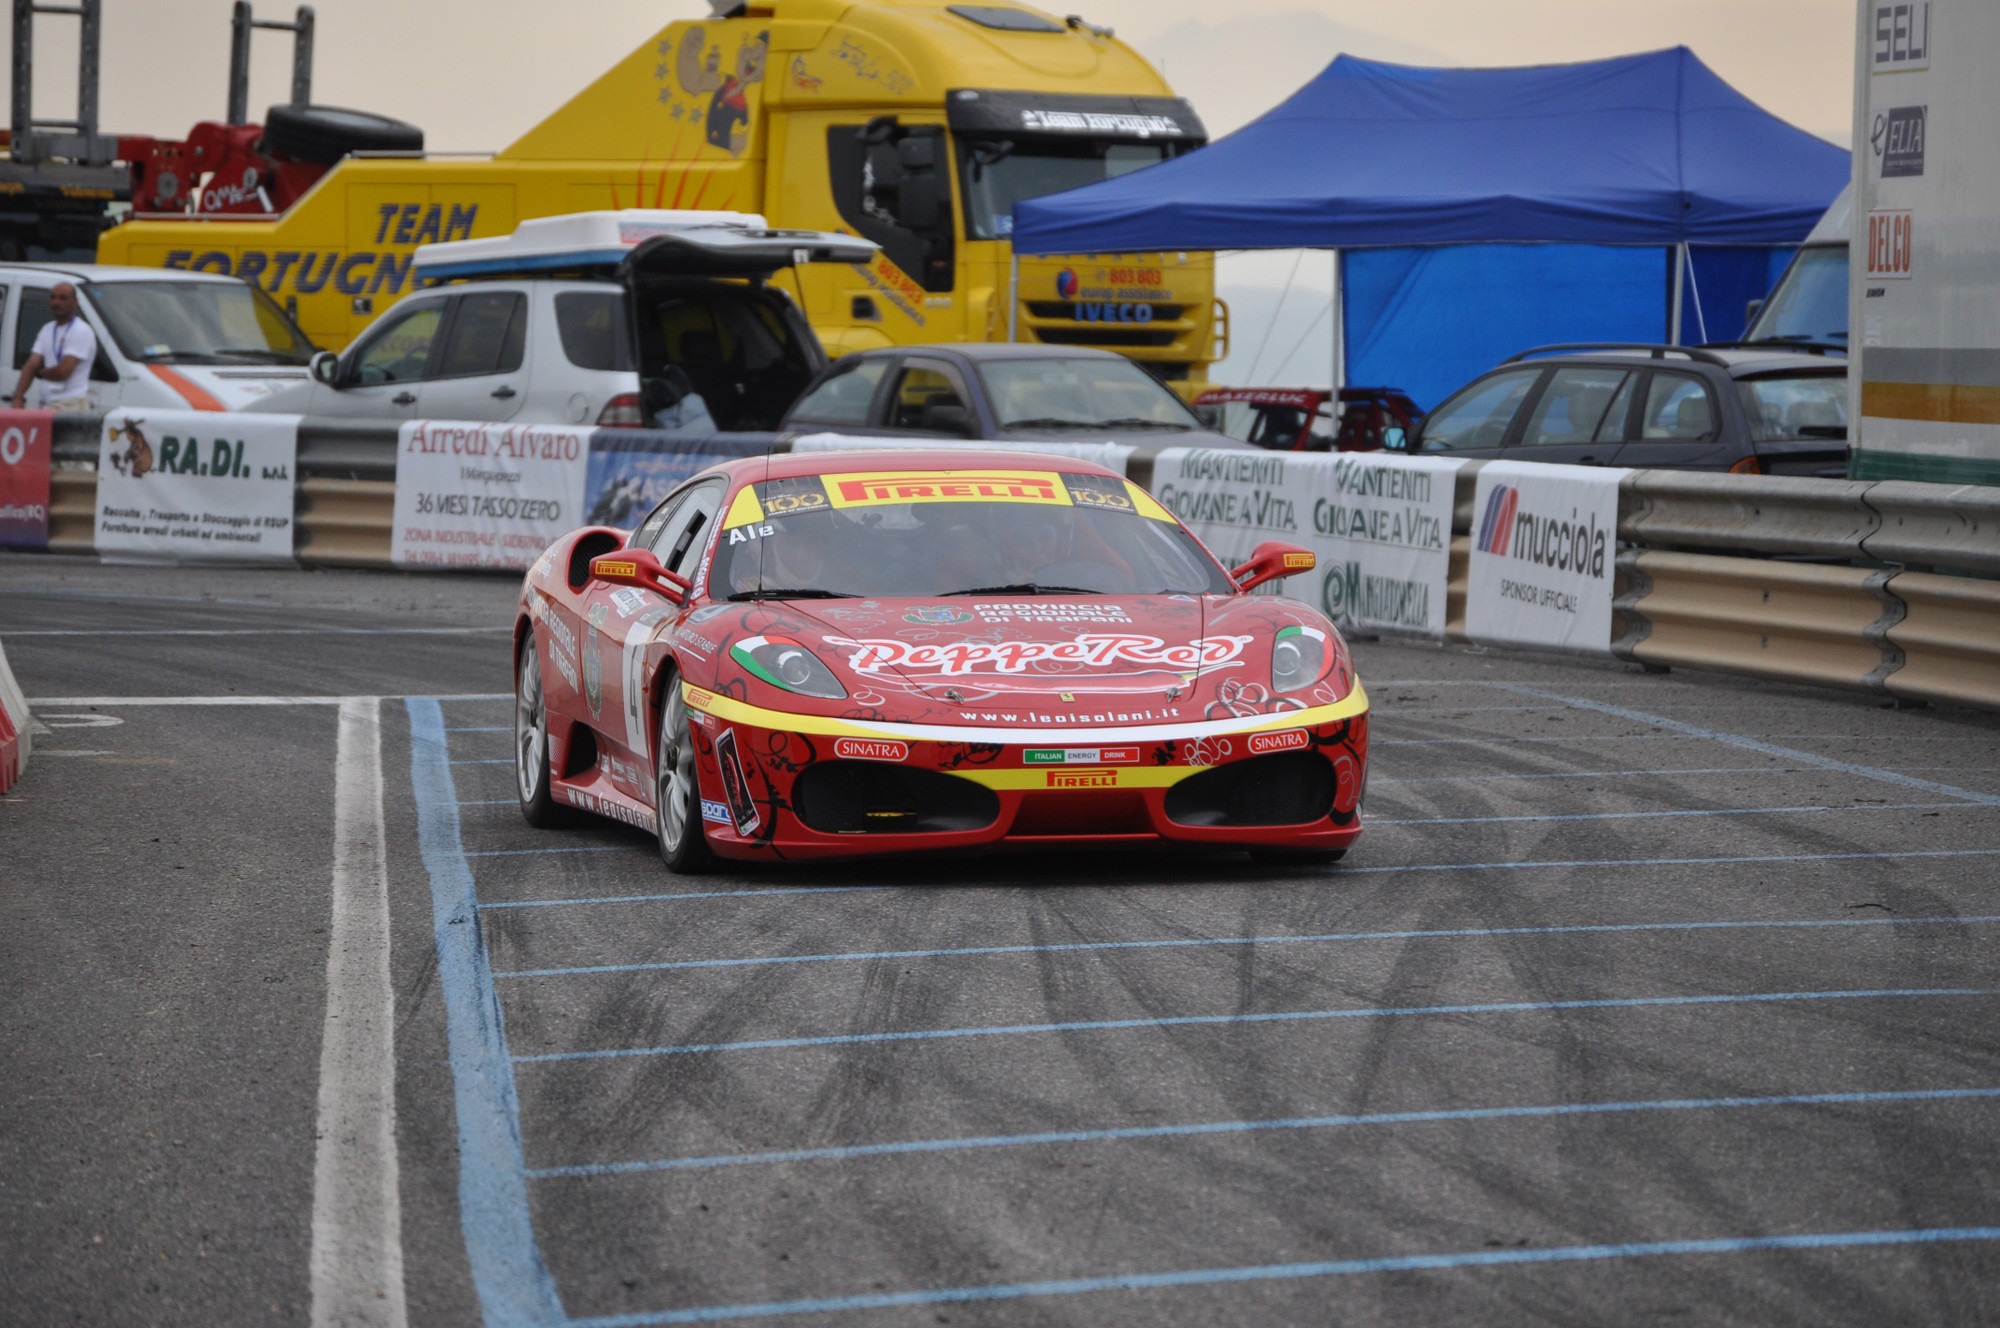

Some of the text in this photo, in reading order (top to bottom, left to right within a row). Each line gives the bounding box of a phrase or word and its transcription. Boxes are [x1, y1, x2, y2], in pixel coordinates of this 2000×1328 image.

[1876, 2, 1928, 63] SELI
[375, 203, 478, 244] TEAM
[1868, 215, 1911, 273] DELCO
[160, 250, 434, 294] FORTUGN
[1110, 268, 1162, 285] 803 803
[1075, 302, 1153, 324] IVECO
[408, 420, 580, 461] Arredi Alvaro
[158, 435, 250, 478] RA.DI.
[838, 476, 1057, 502] PIRELLI
[1070, 490, 1131, 508] 100
[415, 493, 433, 514] 36
[472, 496, 516, 519] TASSO
[520, 499, 561, 521] ZERO
[766, 493, 825, 512] 100
[1514, 507, 1605, 580] mucciola
[597, 562, 635, 576] PIRELLI
[1285, 555, 1314, 566] PIRELLI
[1501, 578, 1538, 604] SPONSOR
[687, 688, 713, 708] PIRELLI
[841, 741, 901, 758] SINATRA
[1254, 732, 1305, 750] SINATRA
[1033, 750, 1127, 761] ITALIAN ENERGY DRINK
[1046, 770, 1118, 787] PIRELLI
